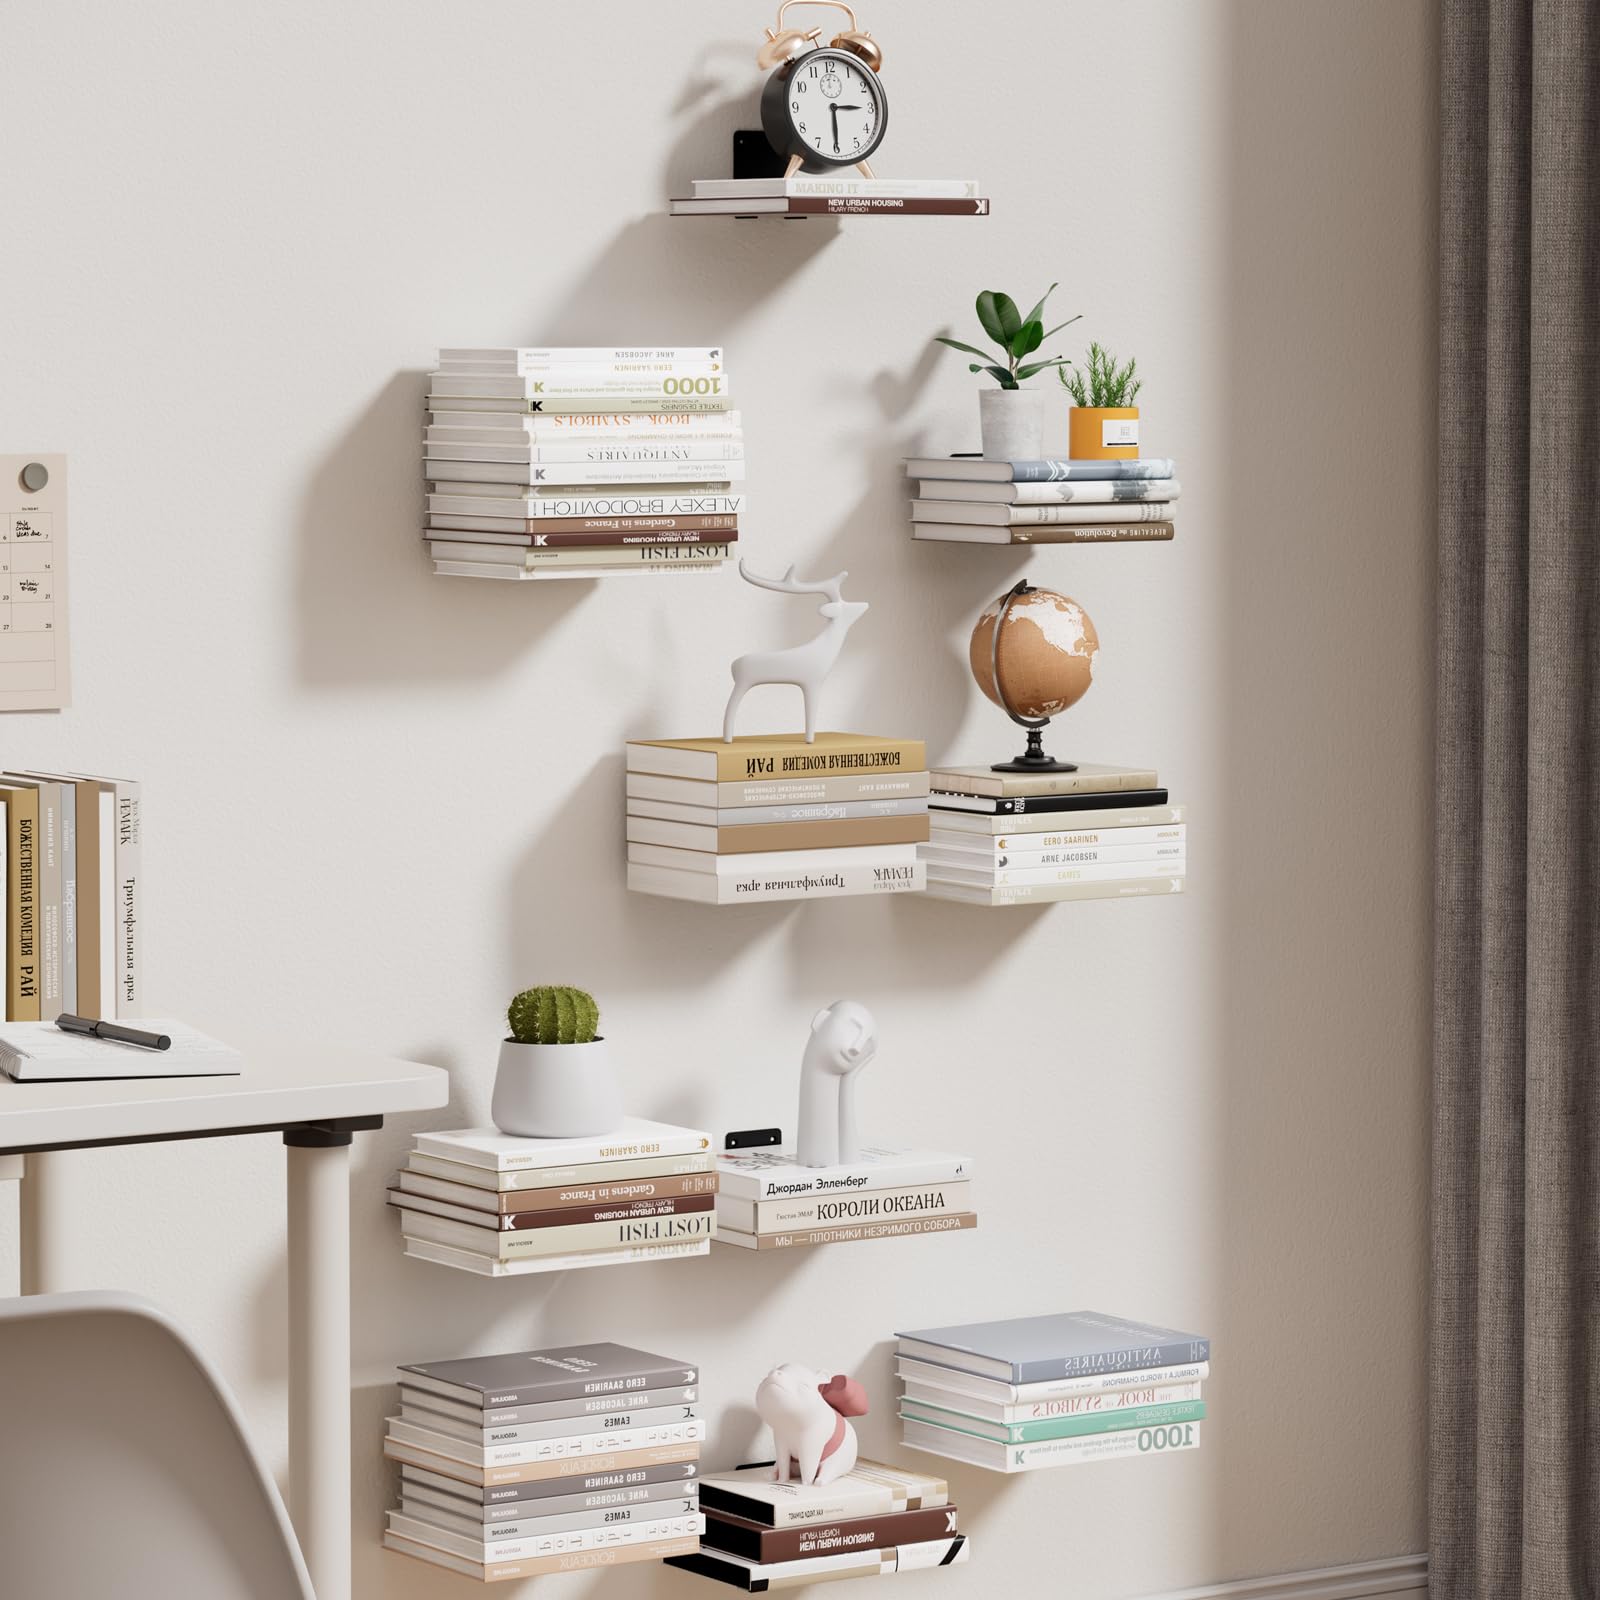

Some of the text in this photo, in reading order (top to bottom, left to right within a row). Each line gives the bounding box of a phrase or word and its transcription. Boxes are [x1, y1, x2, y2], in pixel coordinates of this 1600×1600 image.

[809, 67, 818, 78] 11
[825, 61, 835, 73] 12
[797, 81, 807, 93] 10
[860, 82, 867, 93] 2
[792, 102, 799, 113] 9
[867, 102, 874, 114] 3
[799, 122, 806, 133] 8
[863, 123, 870, 133] 4
[815, 137, 821, 148] 7
[853, 138, 860, 149] 5
[795, 184, 844, 194] MAKING
[847, 184, 859, 194] IT
[663, 377, 721, 395] 1000
[533, 401, 543, 411] K
[554, 414, 690, 426] BOOK SYMBOLS
[587, 450, 689, 460] ANTIQUAIRES
[535, 469, 545, 479] K
[543, 498, 740, 515] ALEXEY BRODOVITCH
[585, 519, 675, 528] Gardens in France
[1075, 529, 1116, 537] Revolution
[537, 535, 548, 546] K
[641, 545, 729, 559] LOST FISH
[746, 752, 900, 778] БОЖЕСТВЕННАЯ КОМЕДИЯ РАЙ
[1044, 834, 1098, 845] EERO SAARINEN
[1041, 852, 1098, 863] ARNE JACOBSEN
[873, 867, 913, 880] РЕМАРК
[1057, 871, 1081, 879] EAMES
[736, 874, 845, 893] Триумфальная арка
[20, 819, 37, 997] БОЖЕСТВЕННАЯ КОМЕДИЯ РАЙ
[123, 877, 136, 1001] Триумфальная арка
[600, 1144, 659, 1157] EERO SAARINEN
[767, 1176, 868, 1196] Джордан Элленберг
[560, 1184, 655, 1201] Gardens in France
[632, 1201, 653, 1209] FRENCH
[817, 1192, 945, 1220] КОРОЛИ ОКЕАНА
[594, 1205, 674, 1220] NEW URBAN HOUSING
[503, 1216, 516, 1230] K
[620, 1216, 711, 1242] LOST FISH
[775, 1218, 961, 1248] МЫ ПЛОТНИКИ НЕЗРИМОГО СОБОРА
[1013, 1427, 1024, 1441] K
[1016, 1451, 1024, 1464] K
